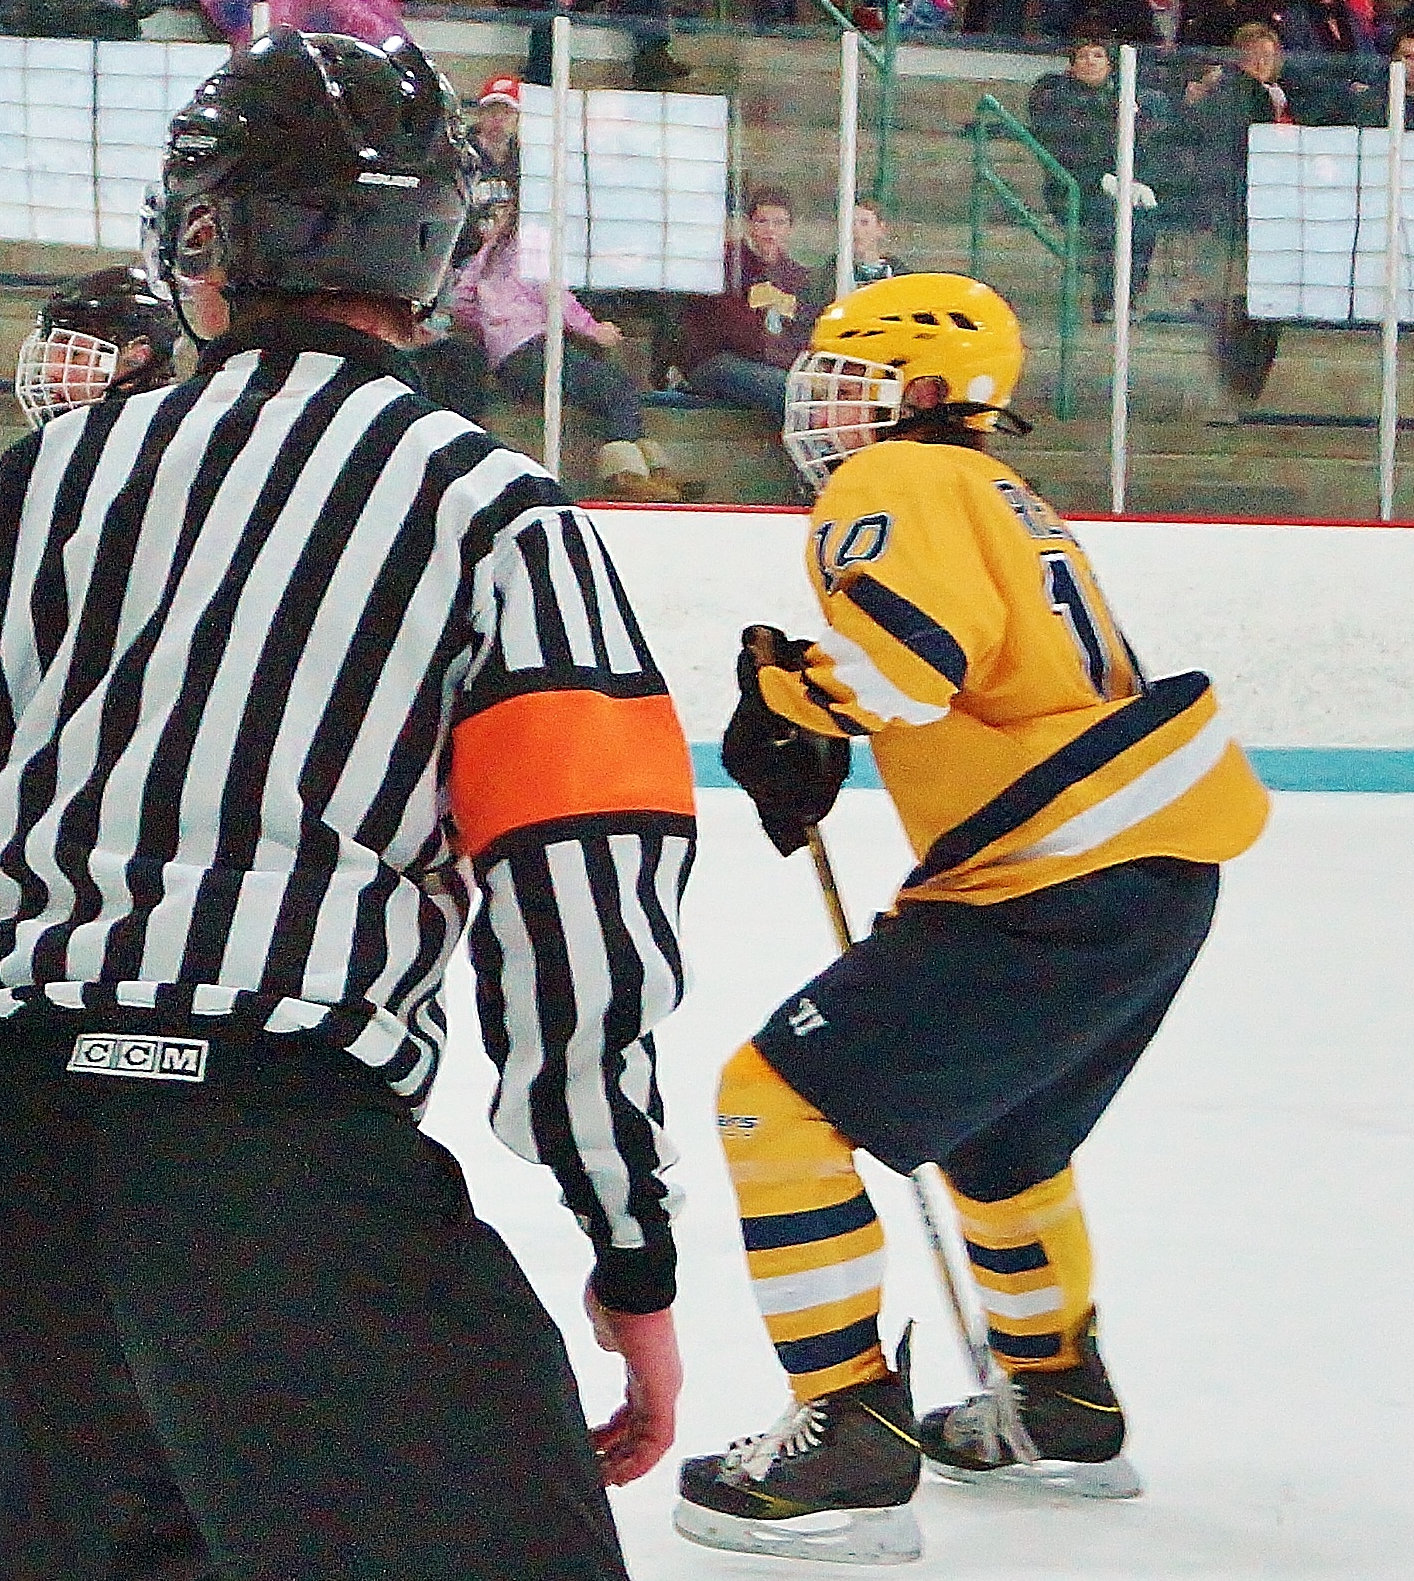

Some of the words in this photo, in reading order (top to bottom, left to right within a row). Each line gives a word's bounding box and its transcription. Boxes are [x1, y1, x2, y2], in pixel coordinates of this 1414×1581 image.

[814, 510, 890, 596] 10
[1040, 550, 1134, 703] 1
[80, 1041, 200, 1074] CCM
